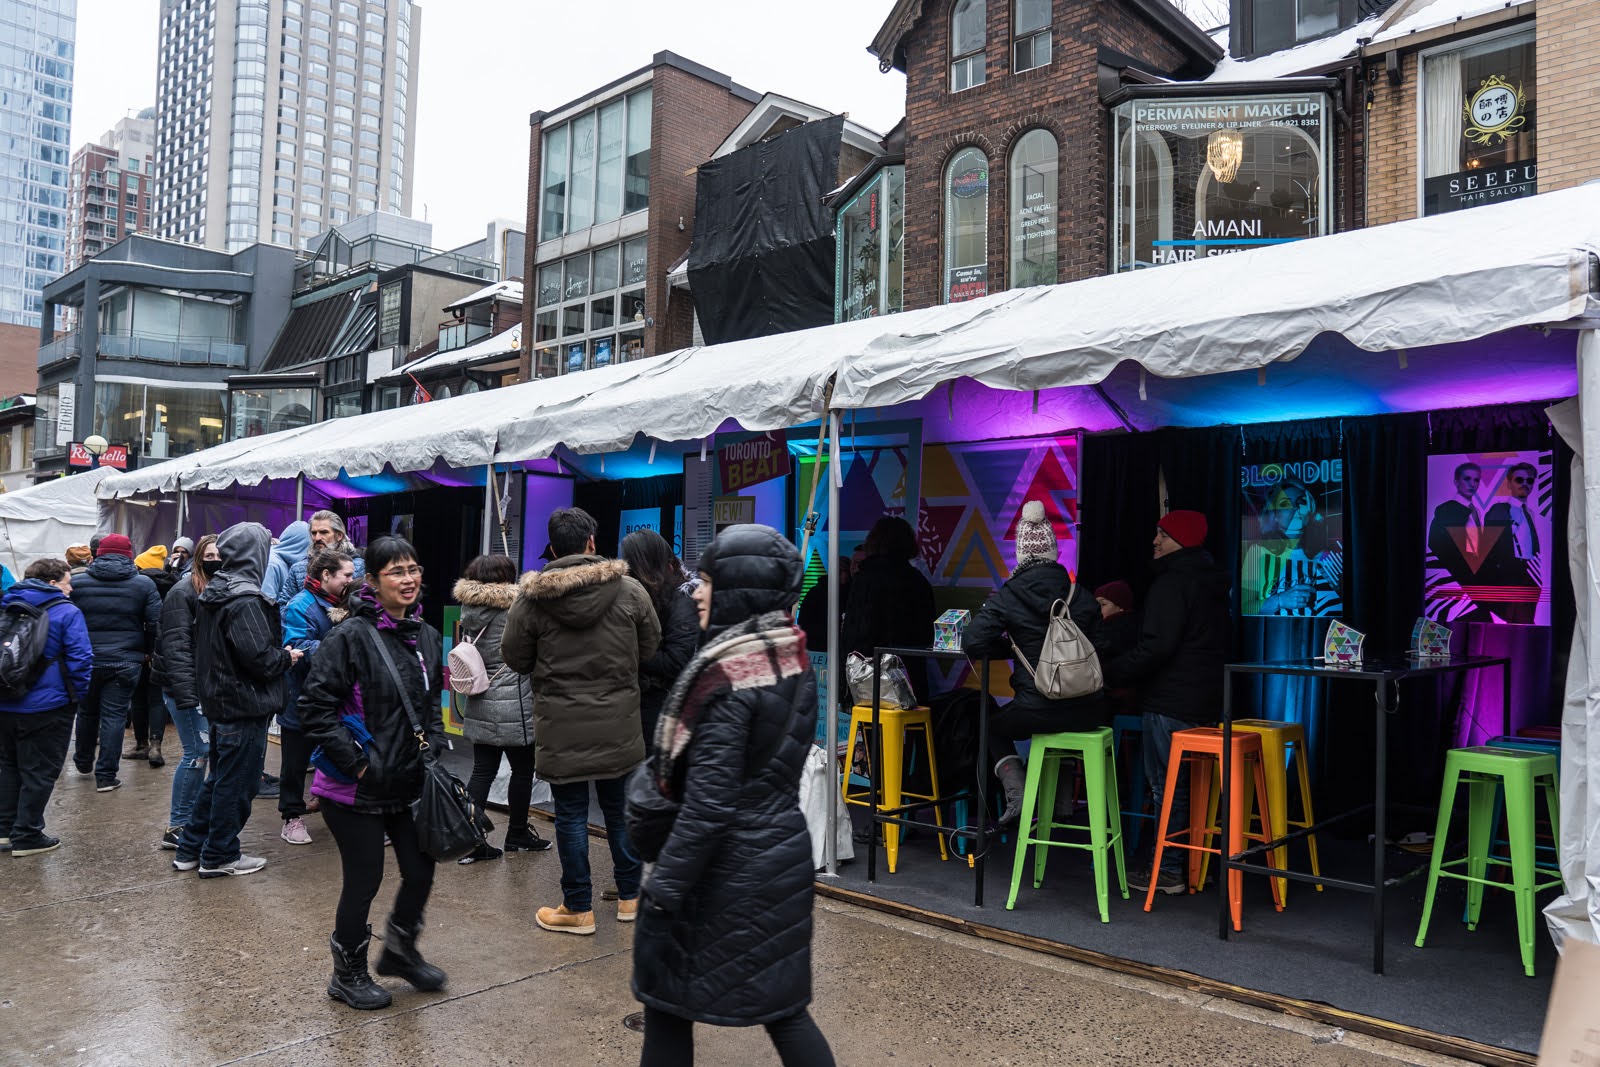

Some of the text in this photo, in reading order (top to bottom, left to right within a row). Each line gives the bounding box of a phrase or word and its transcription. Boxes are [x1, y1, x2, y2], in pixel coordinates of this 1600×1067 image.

[1137, 102, 1320, 121] PERMANENT MAKE UP
[1181, 122, 1216, 130] EYELINER
[1449, 165, 1537, 194] SEEFU
[1026, 192, 1044, 201] FACIAL
[1460, 185, 1526, 202] HAIR SALON
[1033, 203, 1052, 212] FACIAL
[1020, 216, 1050, 228] GREEN PEEL
[1192, 219, 1262, 237] AMANI
[1015, 228, 1056, 242] SKIN TIGHTENING
[1152, 249, 1196, 264] HAIR
[865, 279, 876, 297] SPA
[960, 275, 977, 283] we're
[950, 281, 985, 303] OPEN
[953, 291, 969, 299] NAILS
[975, 287, 986, 295] SPA
[58, 395, 73, 433] FIORIO
[725, 440, 771, 461] TORONTO
[728, 447, 782, 489] BEAT
[1241, 459, 1342, 488] BLONDIE
[713, 502, 743, 522] NEW!
